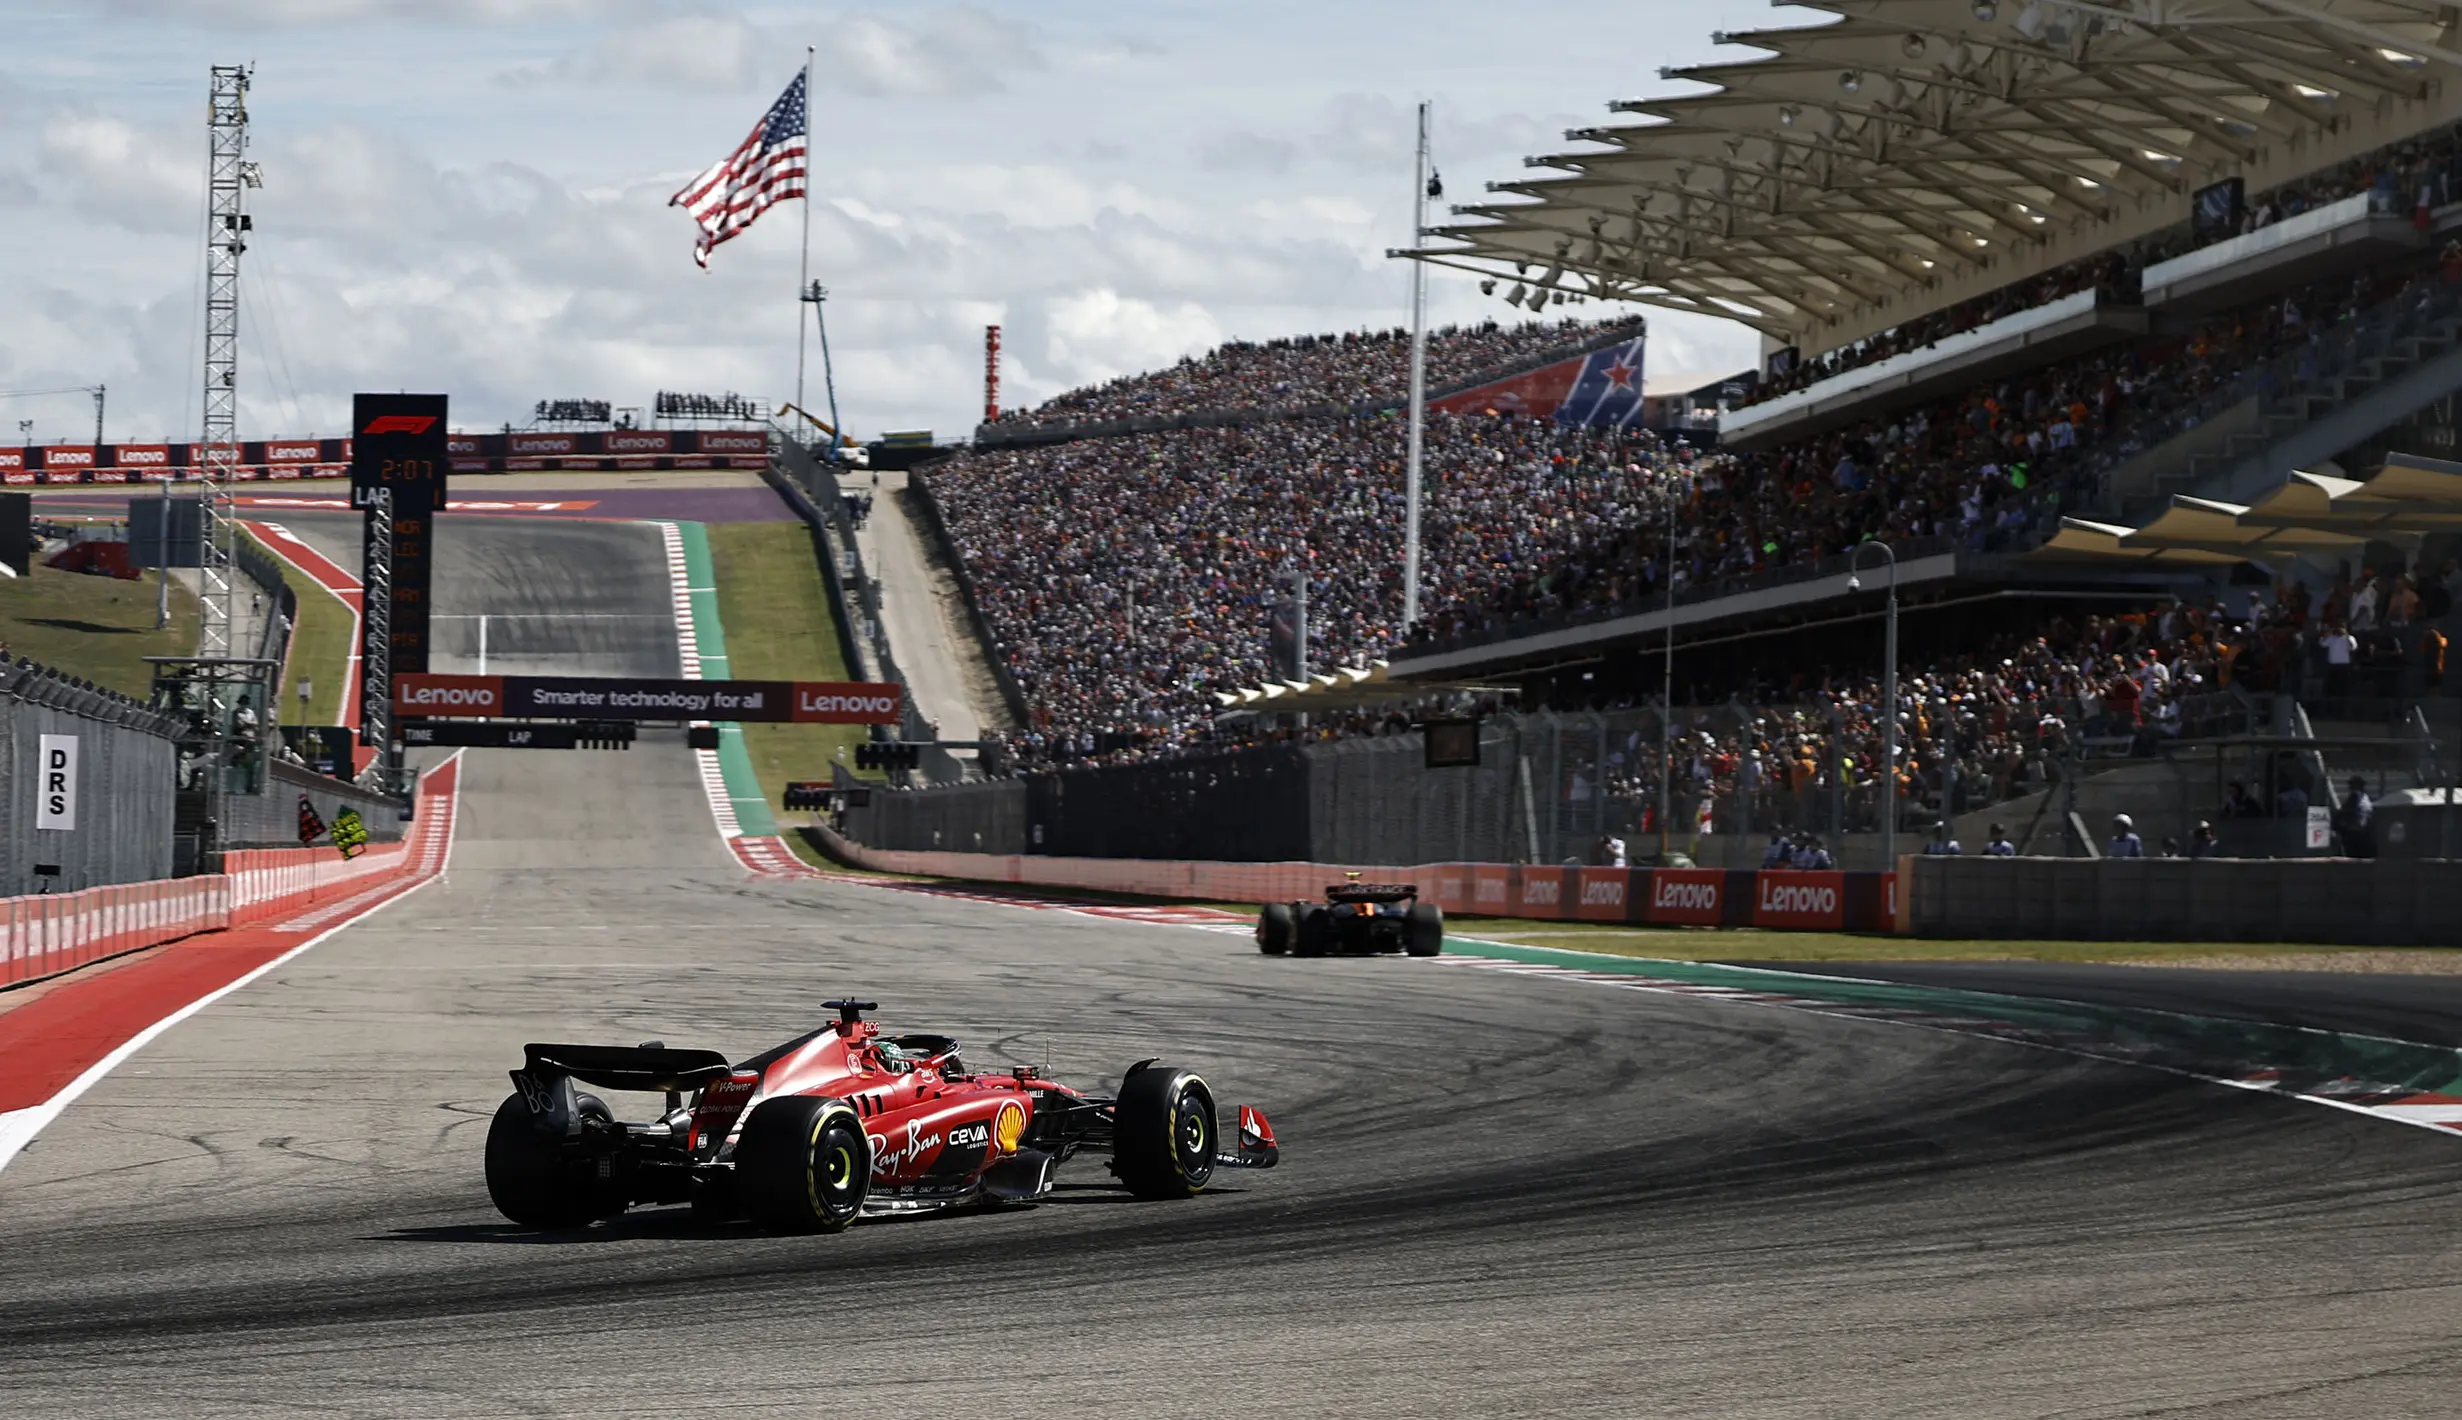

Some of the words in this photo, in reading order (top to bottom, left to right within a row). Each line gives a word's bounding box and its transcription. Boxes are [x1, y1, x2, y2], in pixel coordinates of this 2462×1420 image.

[512, 439, 571, 450] Lenovo
[607, 436, 666, 449] Lenovo
[703, 435, 762, 448] Lenovo
[46, 451, 92, 464] Lenovo
[119, 449, 165, 463] Lenovo
[268, 446, 317, 460] Lenovo
[381, 459, 433, 480] 2:07
[356, 486, 391, 505] LAP
[402, 683, 495, 705] Lenovo
[532, 688, 605, 706] Smarter
[610, 689, 711, 710] technology
[714, 692, 740, 708] for
[743, 693, 763, 709] all
[801, 691, 893, 713] Lenovo
[405, 728, 433, 741] TIME
[508, 731, 532, 743] LAP
[1581, 874, 1624, 905] Lenovo
[1654, 876, 1717, 909] Lenovo
[1760, 879, 1836, 913] Lenovo
[966, 1140, 989, 1150] LOGISTICS
[871, 1186, 894, 1195] brembo
